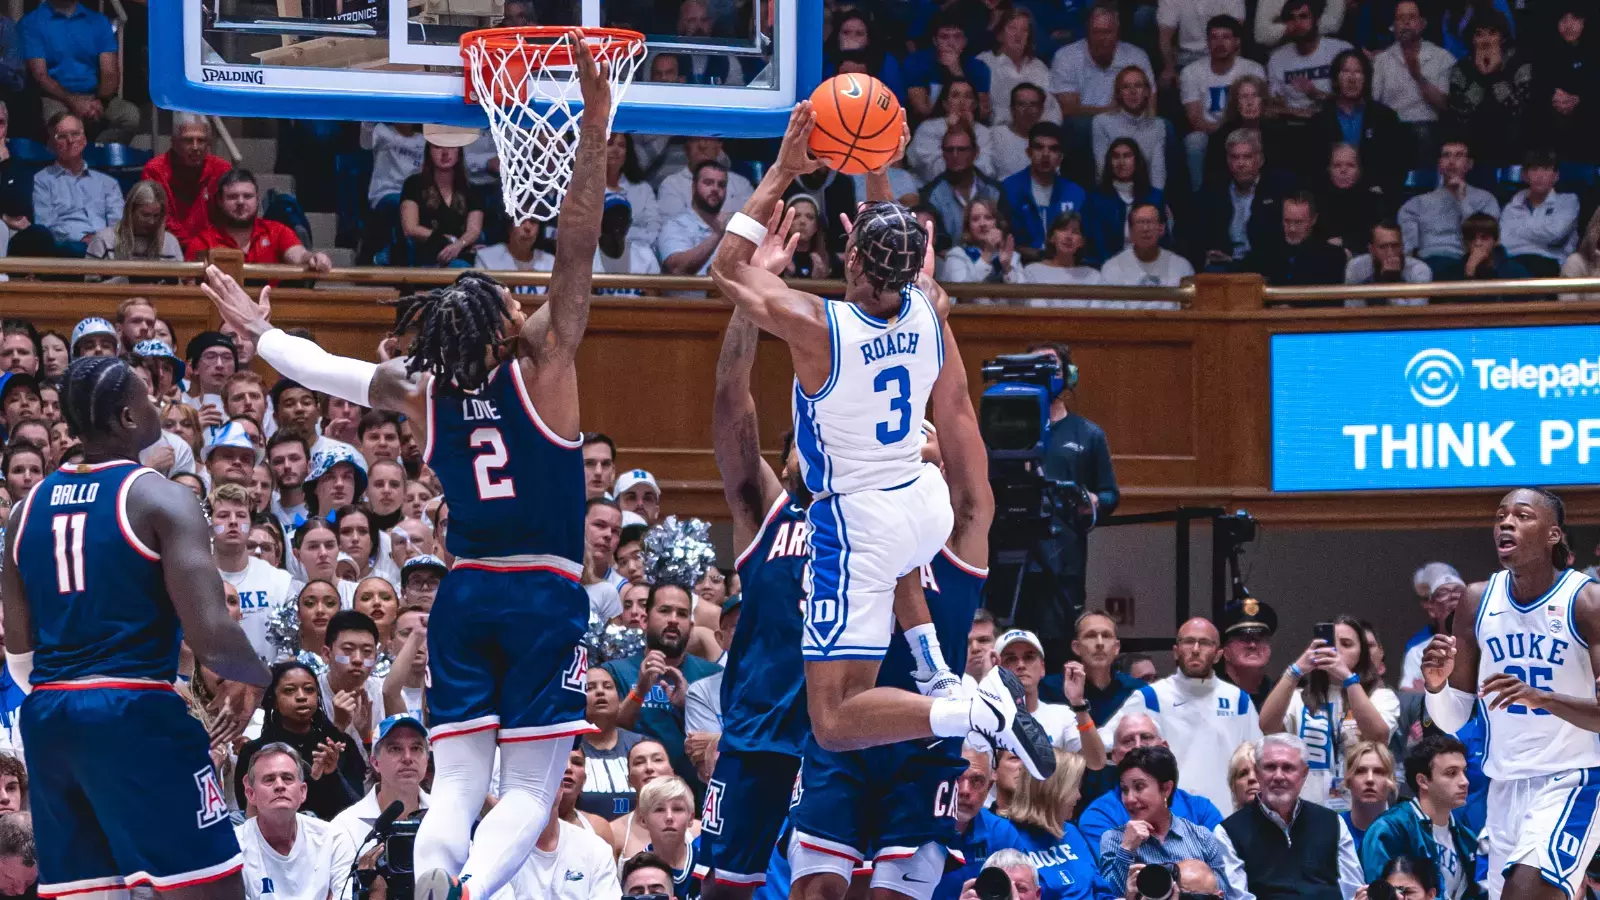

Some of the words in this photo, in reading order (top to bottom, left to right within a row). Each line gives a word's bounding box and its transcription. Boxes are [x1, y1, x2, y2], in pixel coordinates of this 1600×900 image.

[202, 68, 265, 85] SPALDING
[862, 332, 919, 365] ROACH
[1472, 357, 1600, 398] Telepat
[463, 399, 501, 421] LOVE
[874, 365, 912, 446] 3
[470, 427, 516, 499] 2
[1343, 422, 1514, 469] THINK
[50, 482, 100, 506] BALLO
[52, 512, 87, 594] 11
[766, 521, 808, 562] AR
[240, 591, 269, 608] KE
[813, 599, 836, 623] D
[1485, 632, 1570, 667] DUKE
[1503, 665, 1554, 716] 25
[1303, 708, 1331, 766] DUK
[1028, 843, 1079, 869] DUKE
[1558, 831, 1580, 857] D
